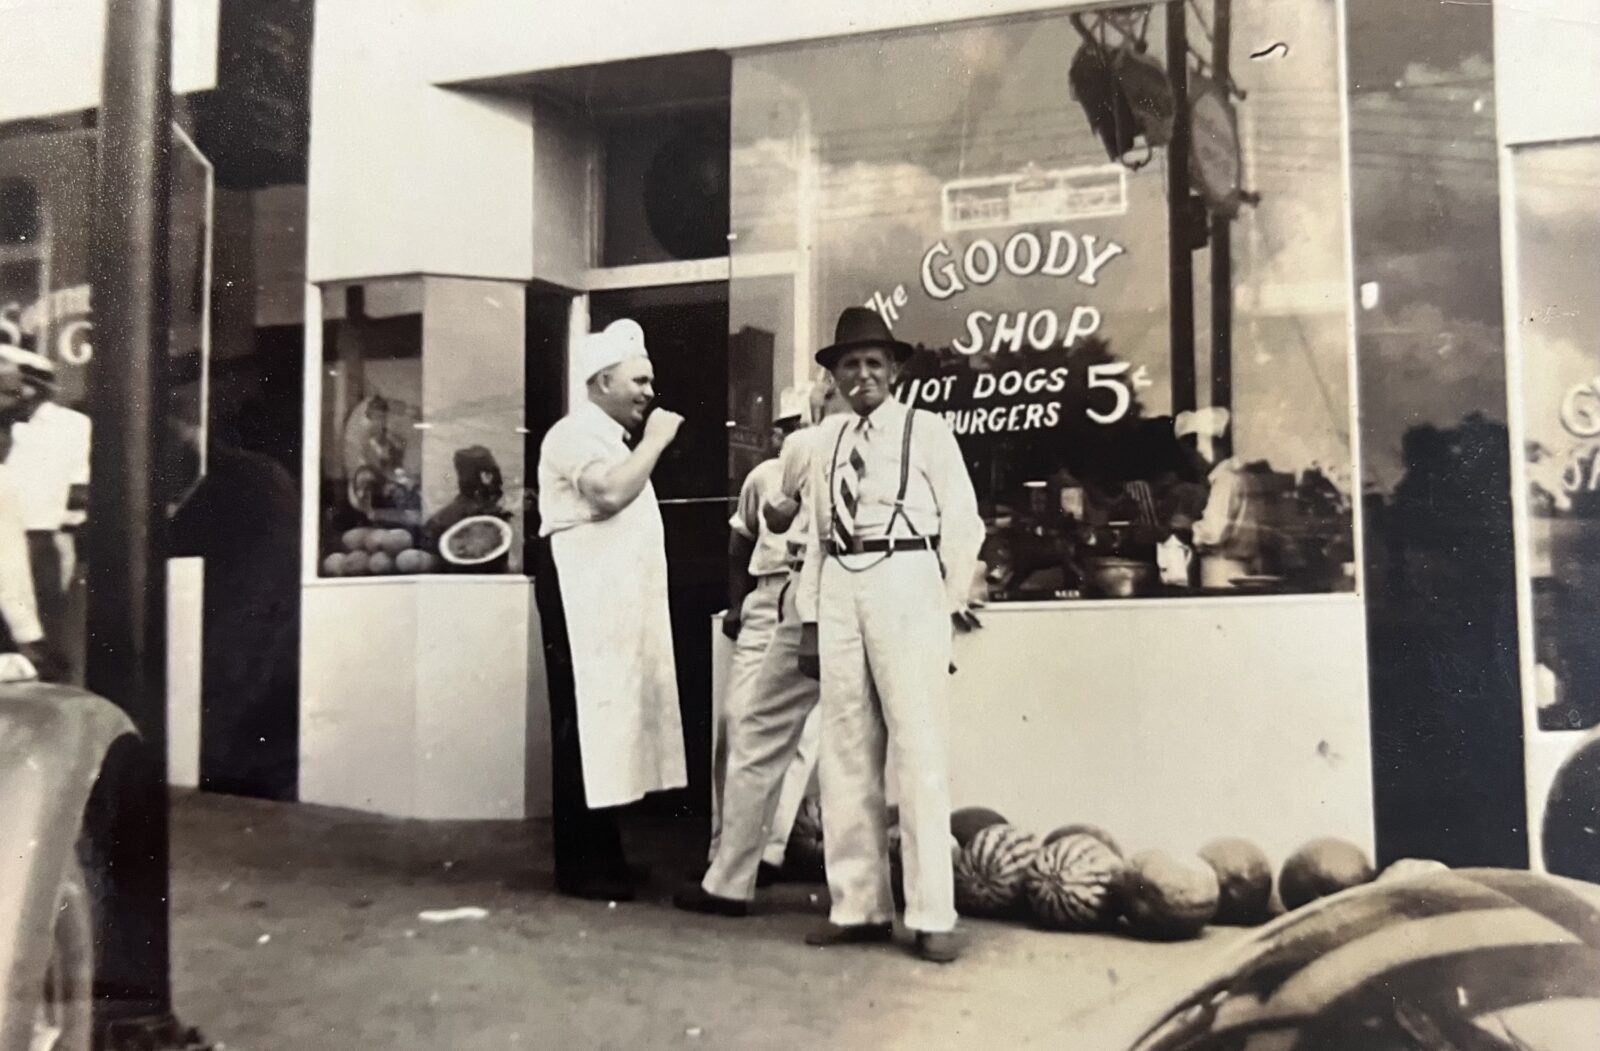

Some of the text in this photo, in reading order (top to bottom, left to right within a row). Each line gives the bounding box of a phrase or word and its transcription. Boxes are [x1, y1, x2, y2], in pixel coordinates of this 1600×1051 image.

[921, 230, 1123, 299] GOODY
[952, 306, 1101, 355] SHOP
[972, 367, 1069, 399] DOGS
[943, 402, 1062, 435] BURGERS
